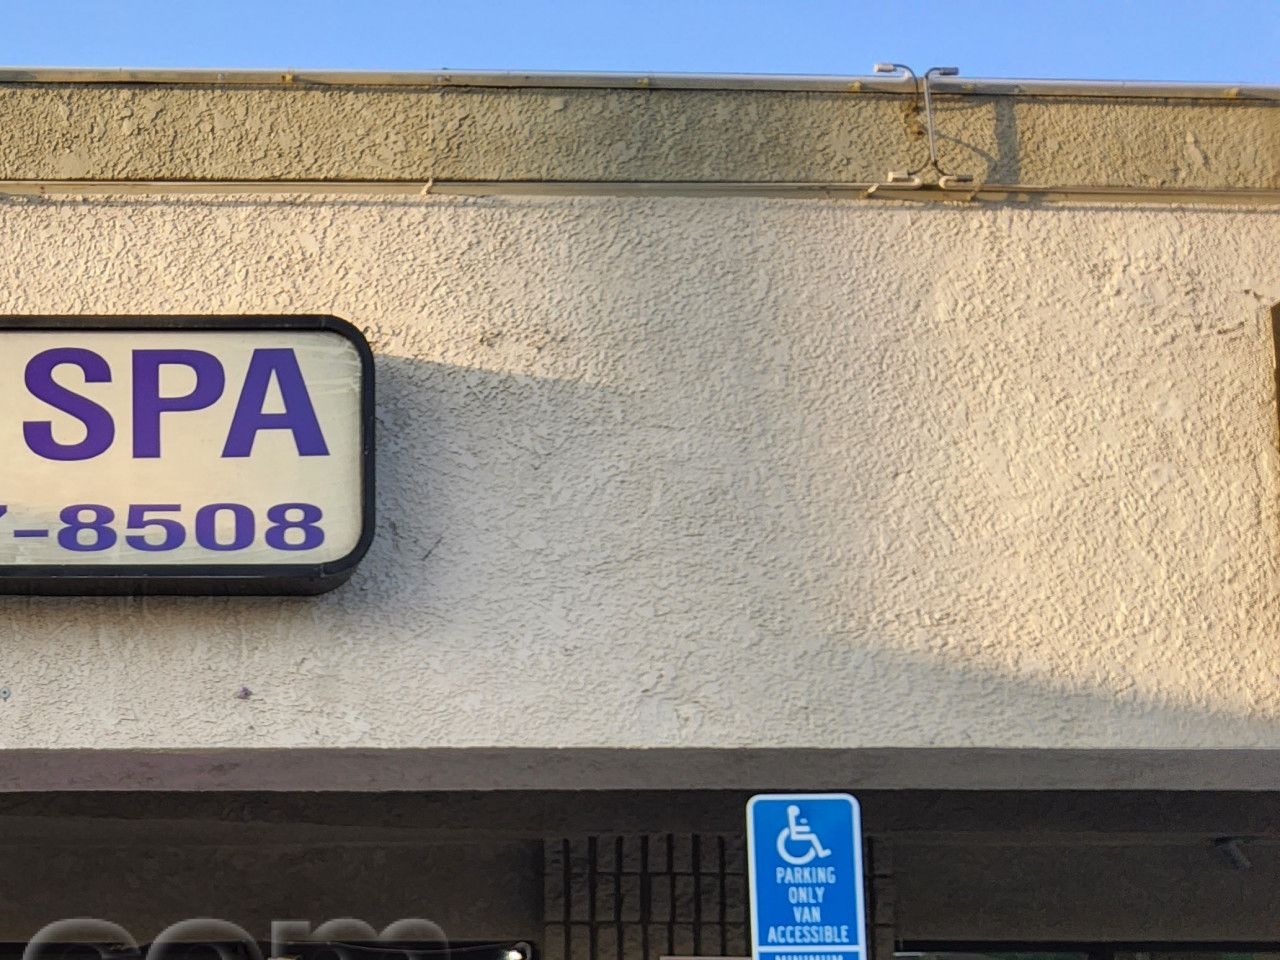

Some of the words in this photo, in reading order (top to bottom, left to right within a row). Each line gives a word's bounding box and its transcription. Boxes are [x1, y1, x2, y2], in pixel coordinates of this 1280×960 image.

[22, 346, 331, 461] SPA
[776, 867, 836, 884] PARKING
[788, 886, 825, 904] ONLY
[793, 906, 821, 923] VAN
[767, 925, 850, 943] ACCESSIBLE
